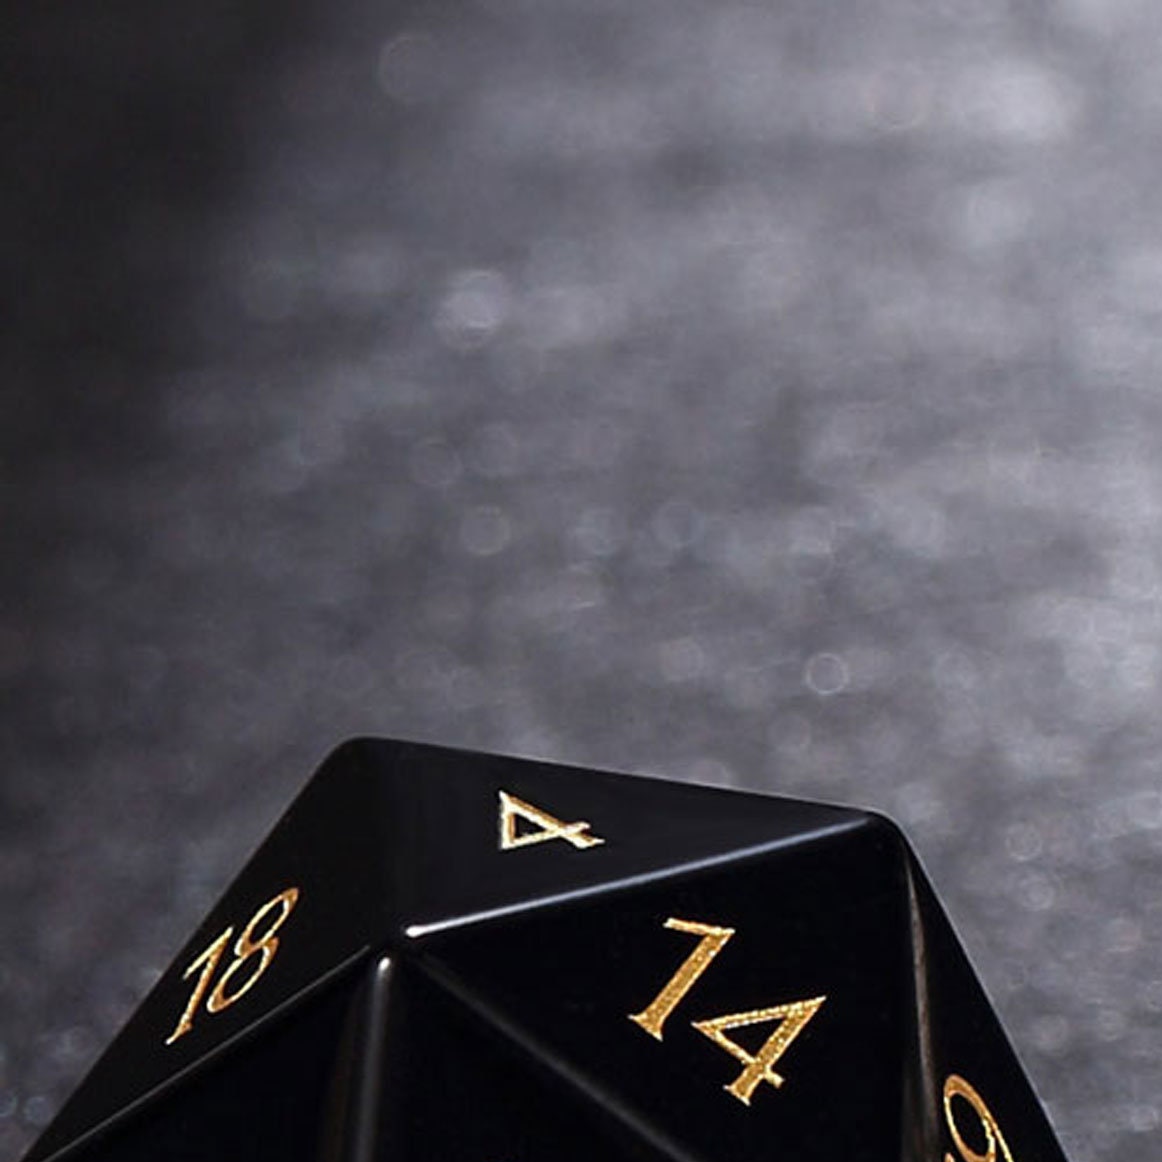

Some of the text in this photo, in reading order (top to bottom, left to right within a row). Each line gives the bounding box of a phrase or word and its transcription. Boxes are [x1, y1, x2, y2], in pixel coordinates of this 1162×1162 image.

[499, 789, 606, 850] 4
[164, 887, 299, 1046] 18
[626, 916, 828, 1107] 14
